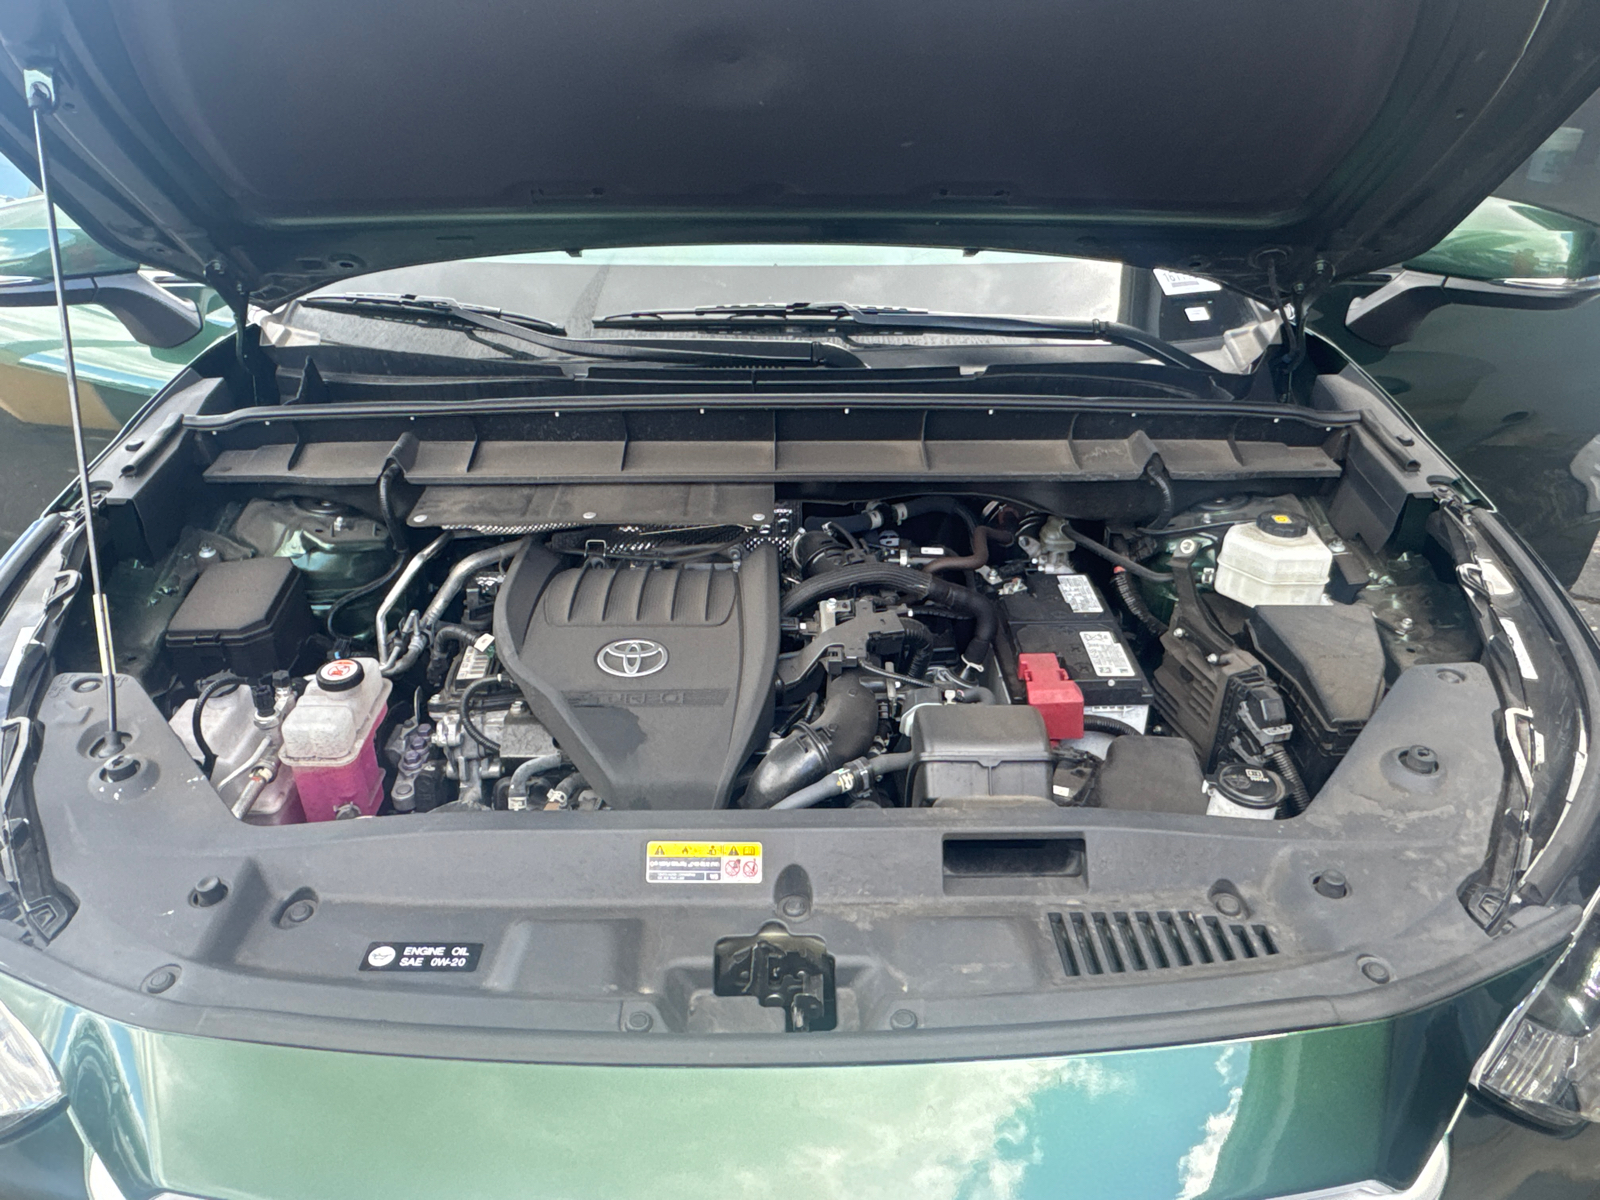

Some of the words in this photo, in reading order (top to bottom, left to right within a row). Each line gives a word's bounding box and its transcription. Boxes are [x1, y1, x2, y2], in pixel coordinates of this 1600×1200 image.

[403, 946, 446, 956] ENGINE
[451, 946, 470, 956] OIL
[399, 958, 424, 967] SAE
[430, 958, 466, 967] 0W-20
